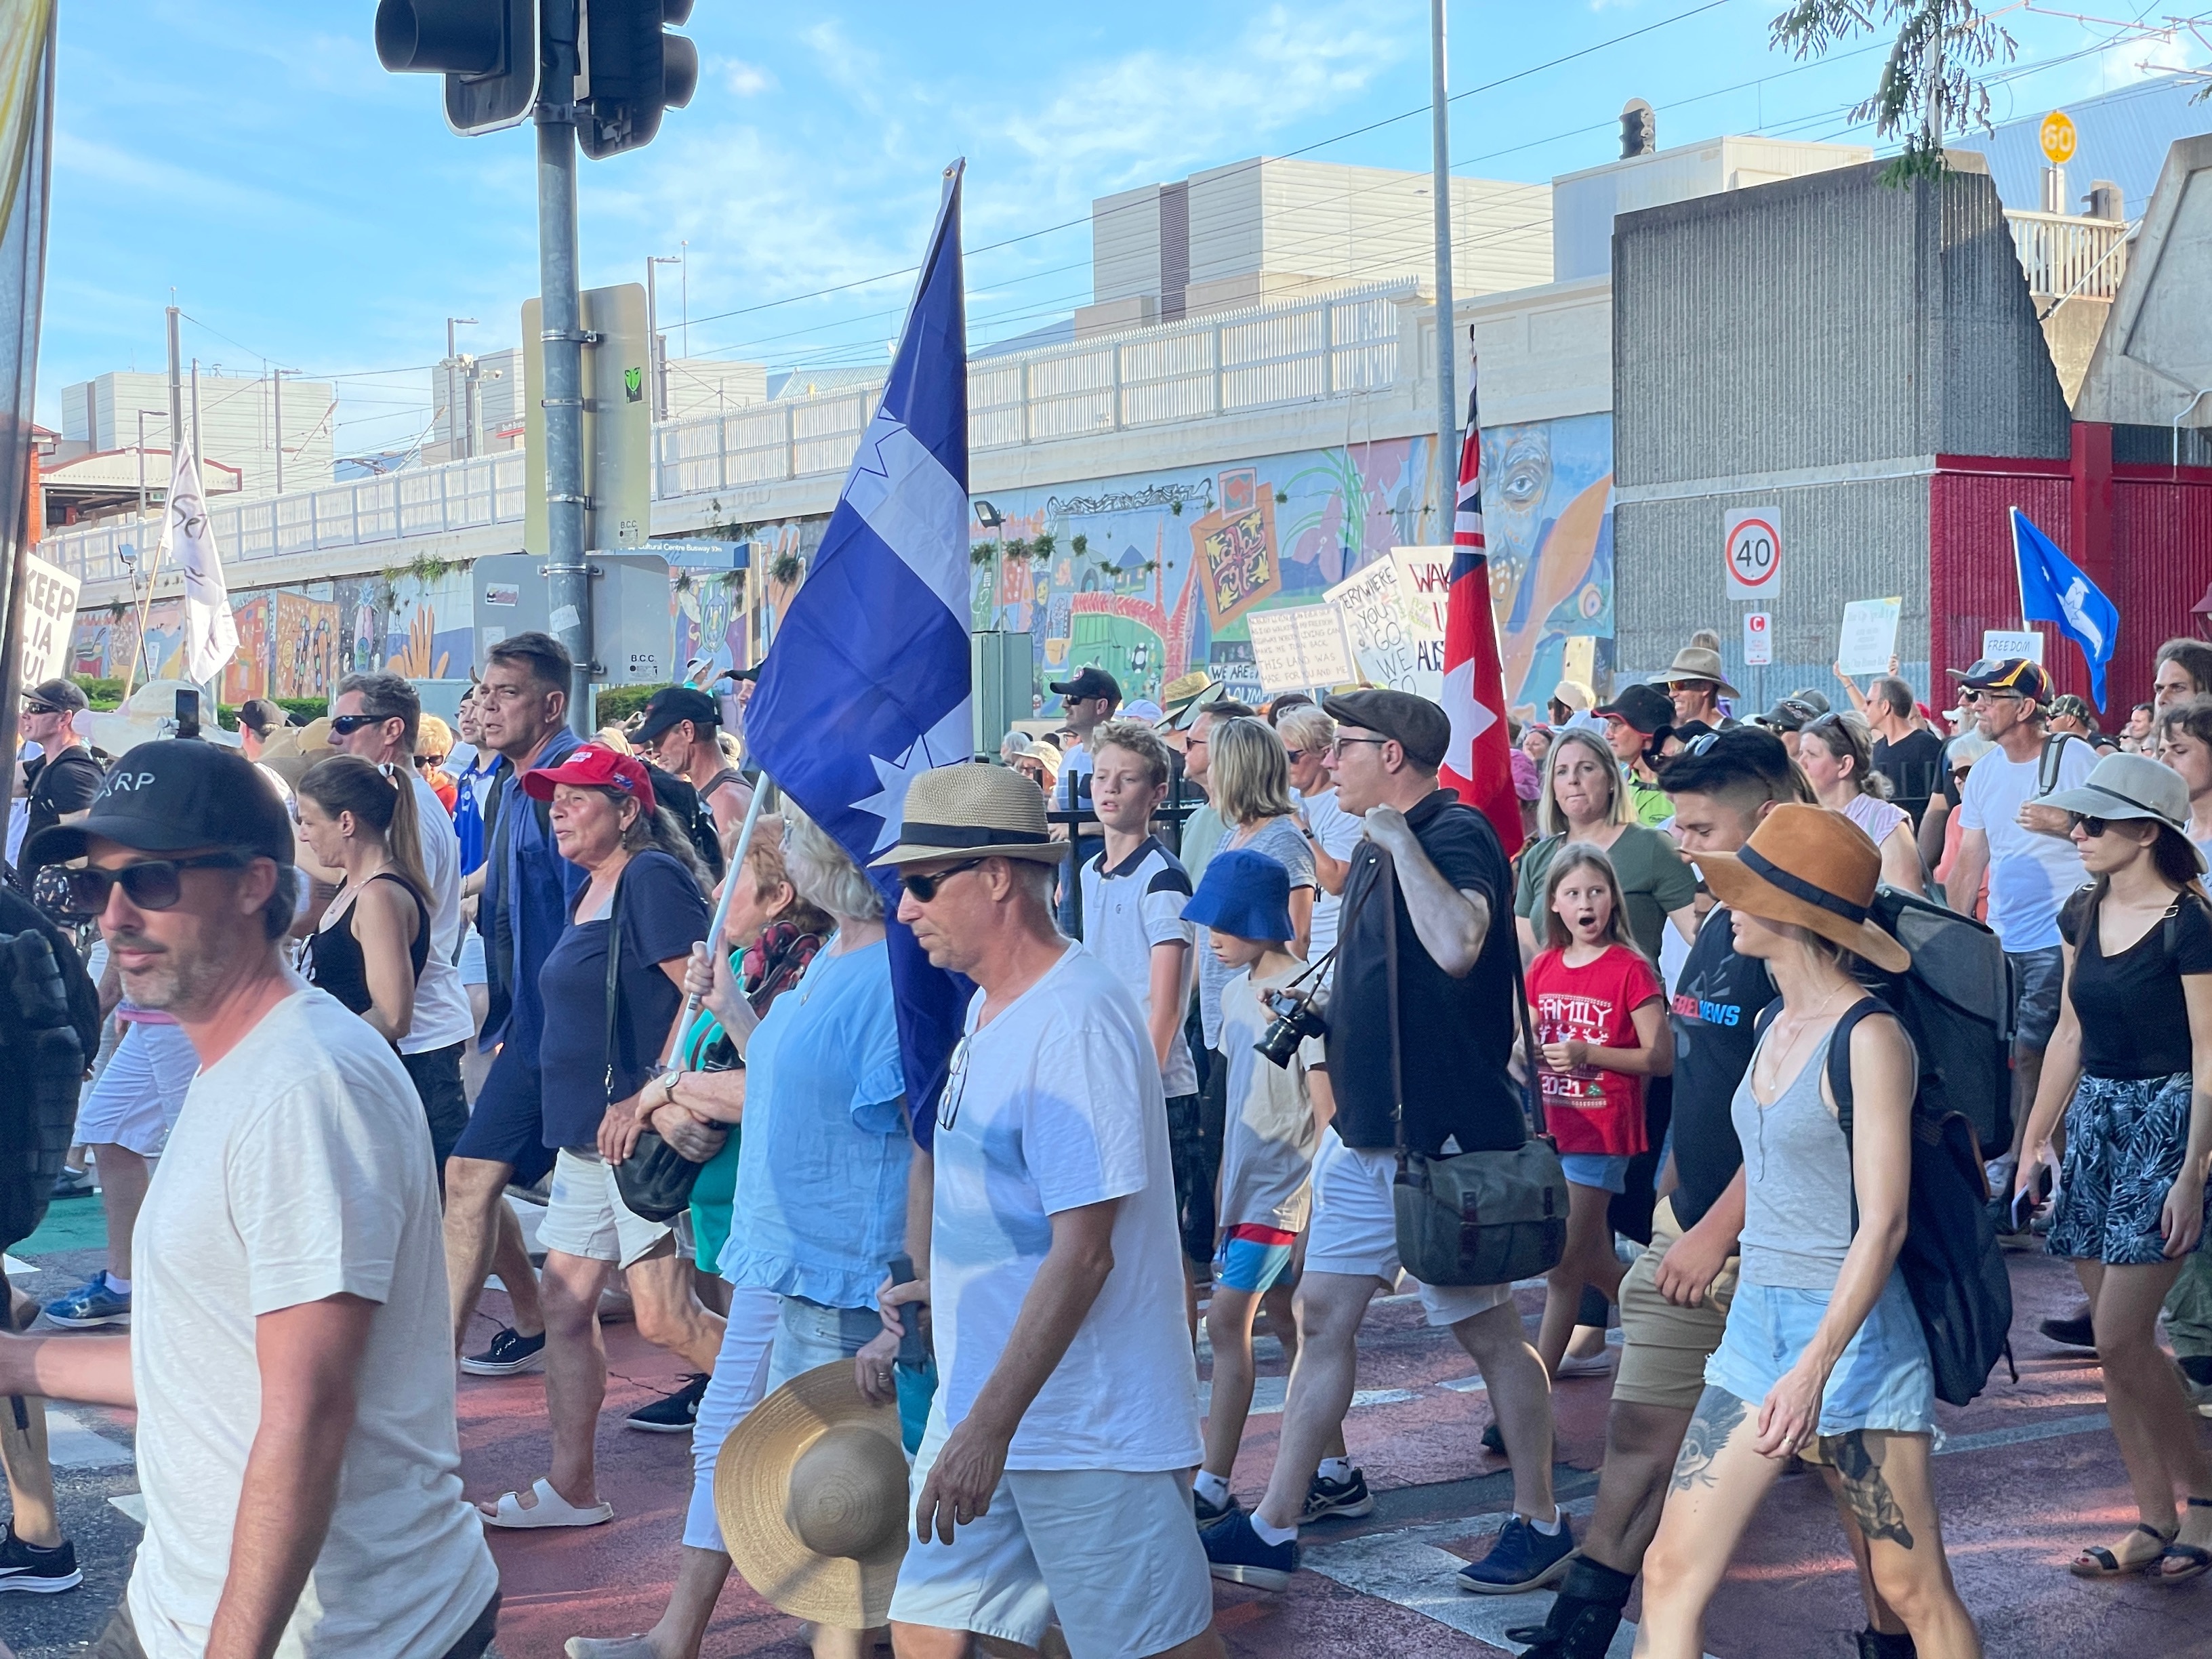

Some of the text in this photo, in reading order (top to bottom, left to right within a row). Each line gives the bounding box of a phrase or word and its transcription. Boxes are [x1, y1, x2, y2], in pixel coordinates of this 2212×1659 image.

[2044, 124, 2072, 152] 60
[686, 544, 710, 553] Busway
[1736, 538, 1770, 567] 40
[1330, 567, 1397, 609] ERYWHERE
[1357, 602, 1389, 629] YOU
[1753, 617, 1762, 631] C
[1300, 630, 1325, 639] LIVING
[1374, 621, 1401, 651] GO
[1988, 640, 2030, 652] FREEDOM
[1212, 665, 1227, 680] WE
[1230, 665, 1250, 680] ARE
[1258, 653, 1335, 671] THIS LAND WAS
[1376, 647, 1413, 680] WE
[1261, 674, 1281, 684] MADE
[1285, 672, 1300, 680] FOR
[1316, 668, 1330, 676] AND
[1336, 665, 1347, 674] ME
[1542, 1075, 1584, 1098] 2021
